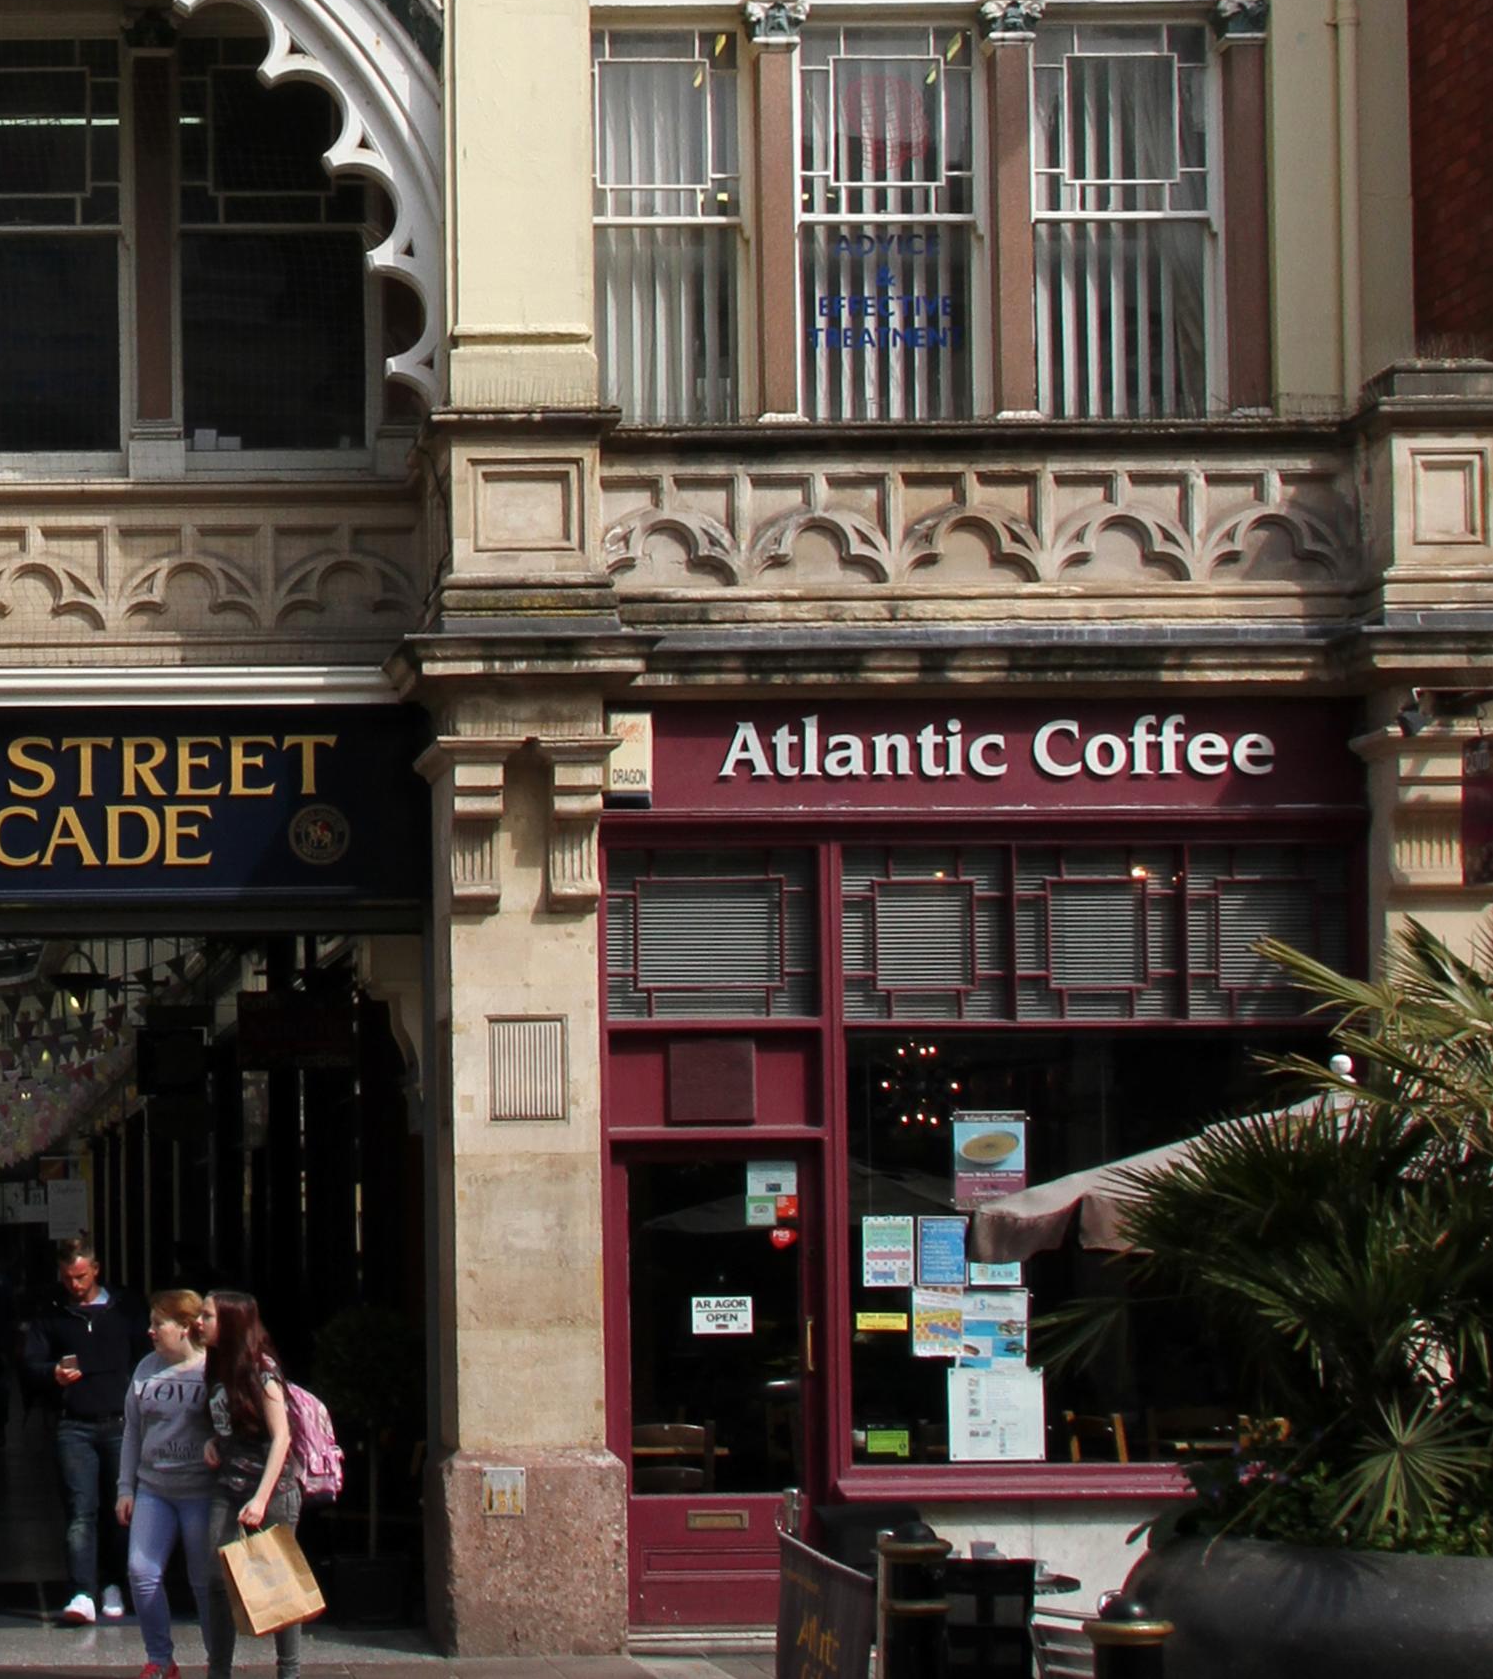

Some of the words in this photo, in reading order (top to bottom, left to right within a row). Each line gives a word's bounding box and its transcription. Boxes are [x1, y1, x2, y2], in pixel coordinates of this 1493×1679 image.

[835, 234, 940, 256] ADVICE
[876, 266, 895, 286] &
[818, 296, 953, 316] EFFECTIVE
[809, 327, 965, 348] TREATMENT
[719, 714, 1007, 777] Atlantic
[1033, 714, 1275, 777] Coffee
[8, 735, 338, 797] STREET
[612, 768, 647, 785] DRAGON
[695, 1300, 712, 1309] AR
[714, 1299, 748, 1309] AGOR
[706, 1313, 738, 1322] OPEN
